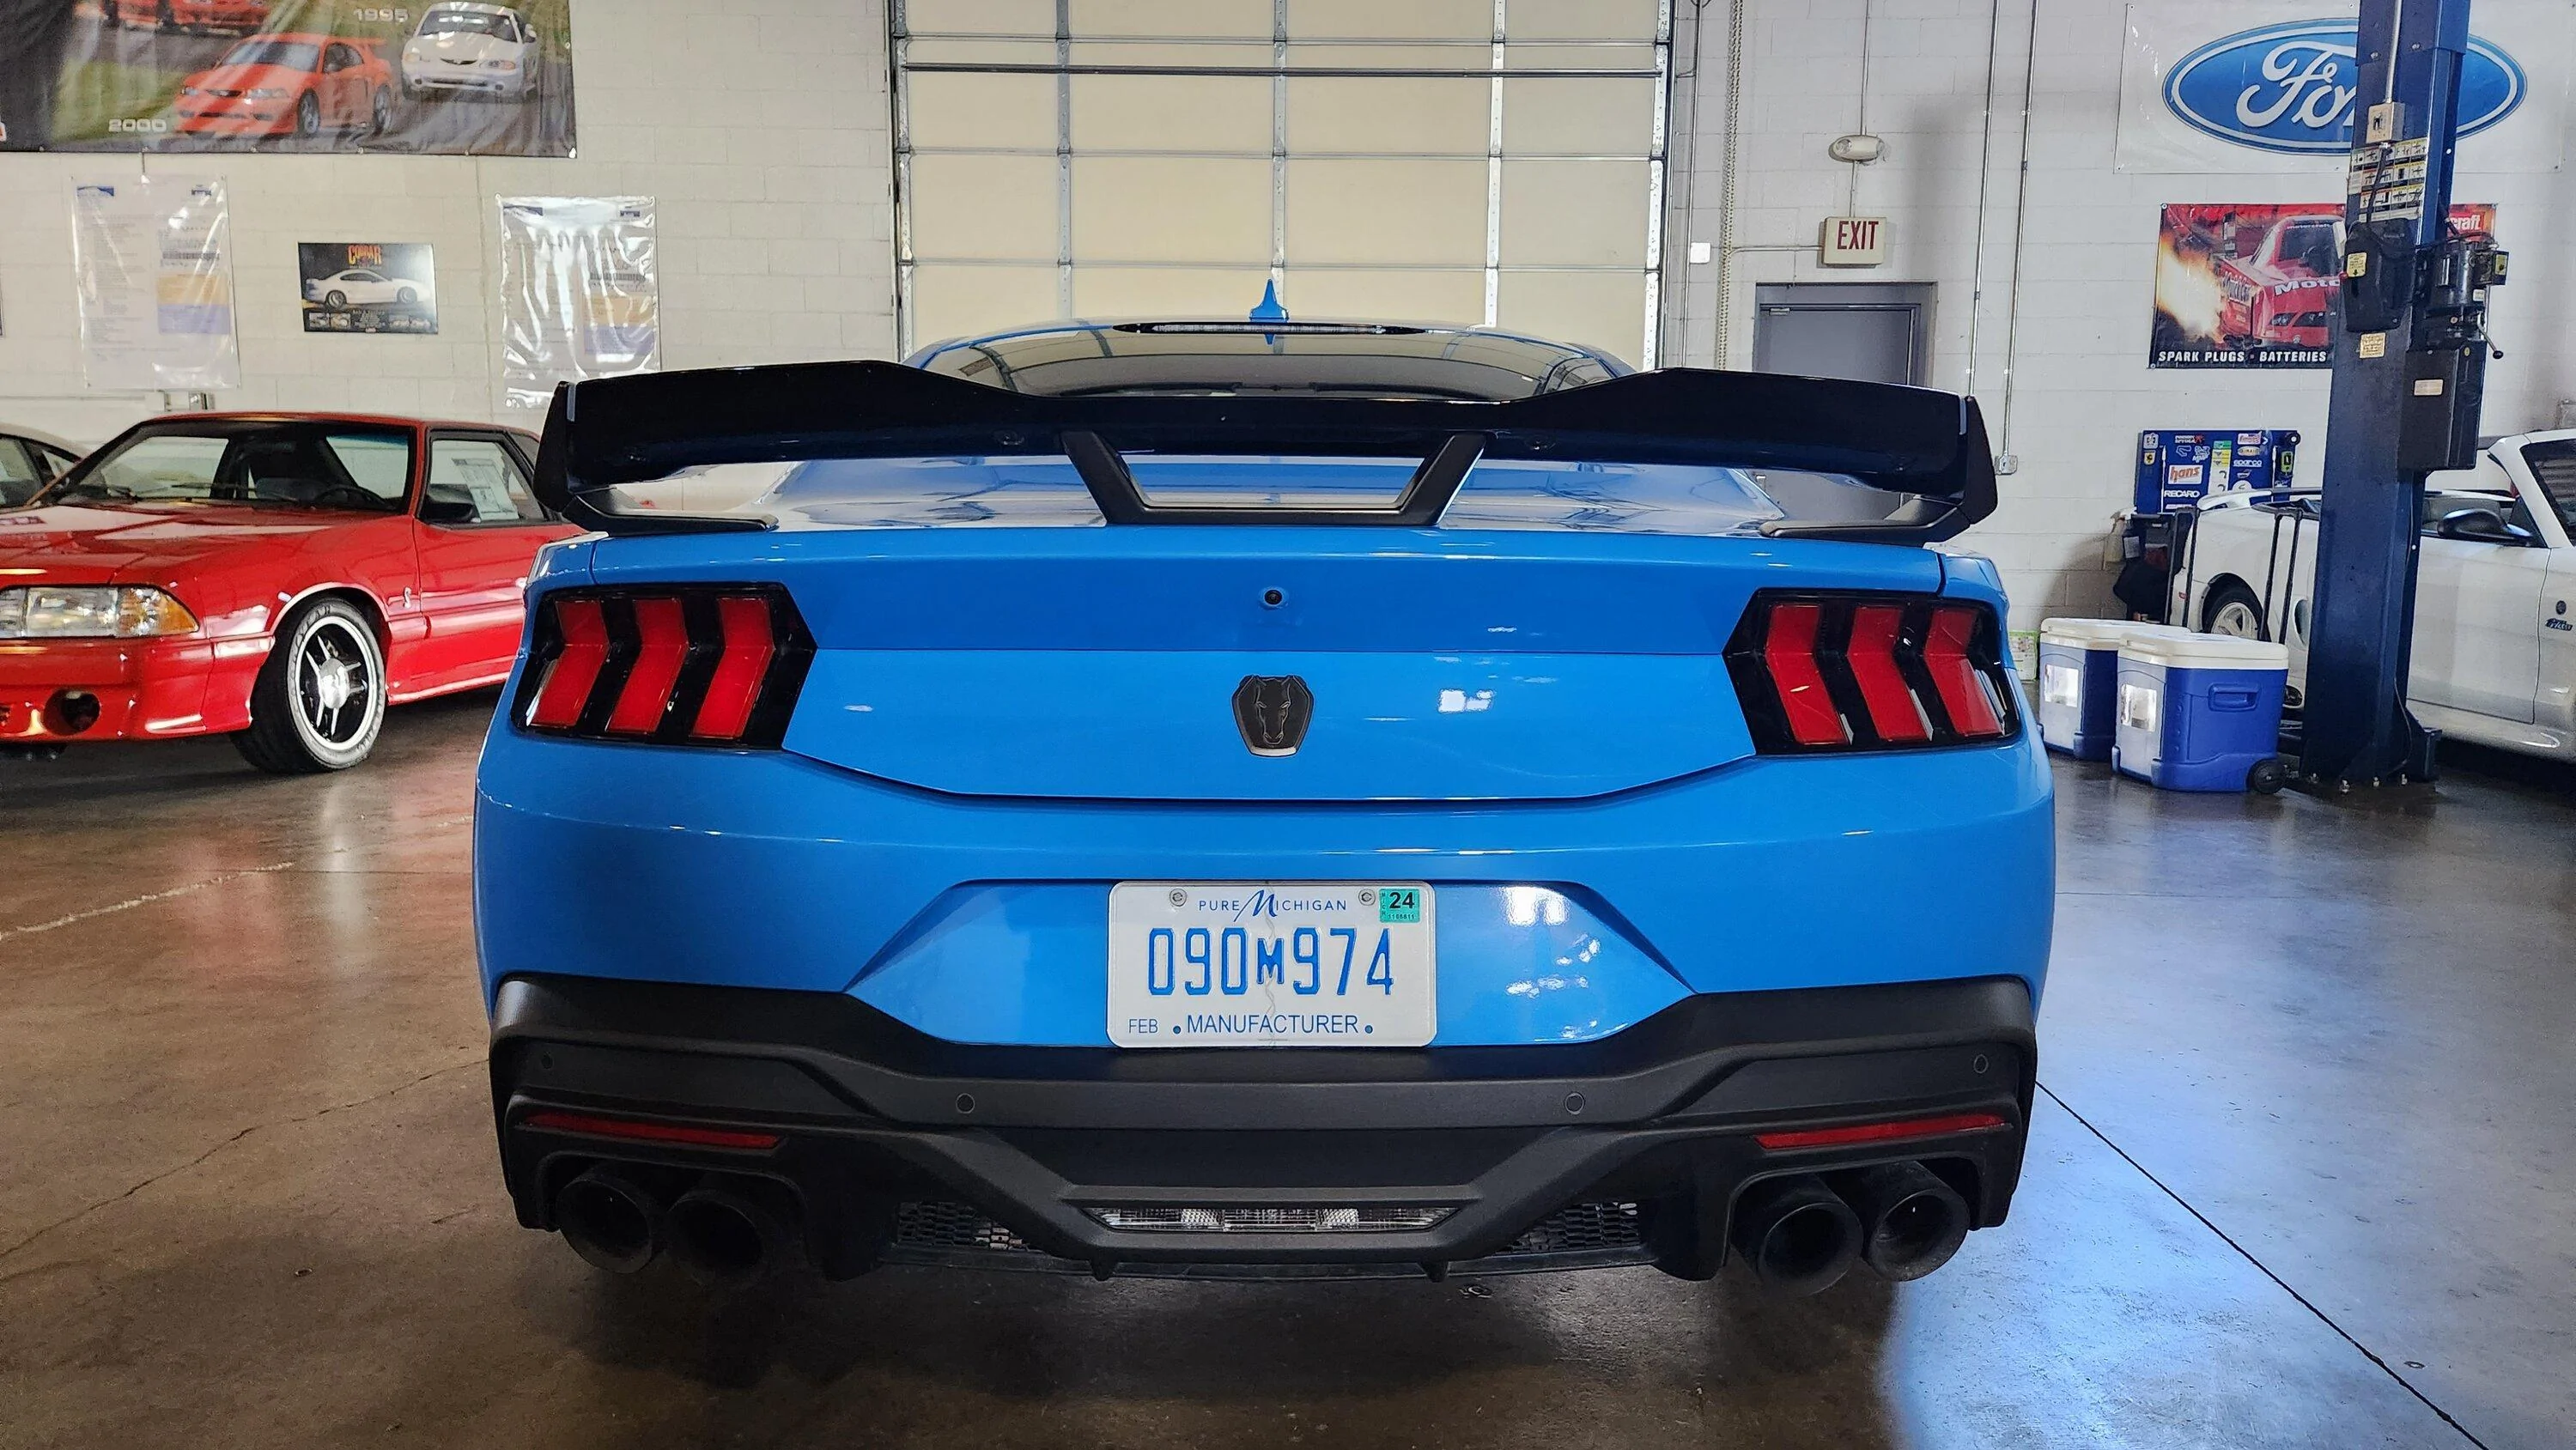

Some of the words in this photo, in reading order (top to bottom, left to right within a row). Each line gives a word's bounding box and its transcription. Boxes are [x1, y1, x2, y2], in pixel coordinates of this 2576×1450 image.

[353, 8, 409, 22] 1995
[2236, 41, 2357, 128] Fo
[108, 118, 167, 132] 2000
[1837, 221, 1879, 250] EXIT
[2274, 278, 2341, 296] Moto
[2158, 351, 2199, 361] SPARK
[2204, 351, 2245, 361] PLUGS
[2259, 350, 2327, 361] BATTERIES
[2170, 466, 2200, 482] hans
[1199, 900, 1240, 911] PURE
[1233, 889, 1346, 923] MICHIGAN
[1389, 892, 1415, 909] 24
[1148, 927, 1394, 996] 090M974
[1128, 1018, 1158, 1034] FEB
[1187, 1015, 1358, 1034] MANUFACTURER
